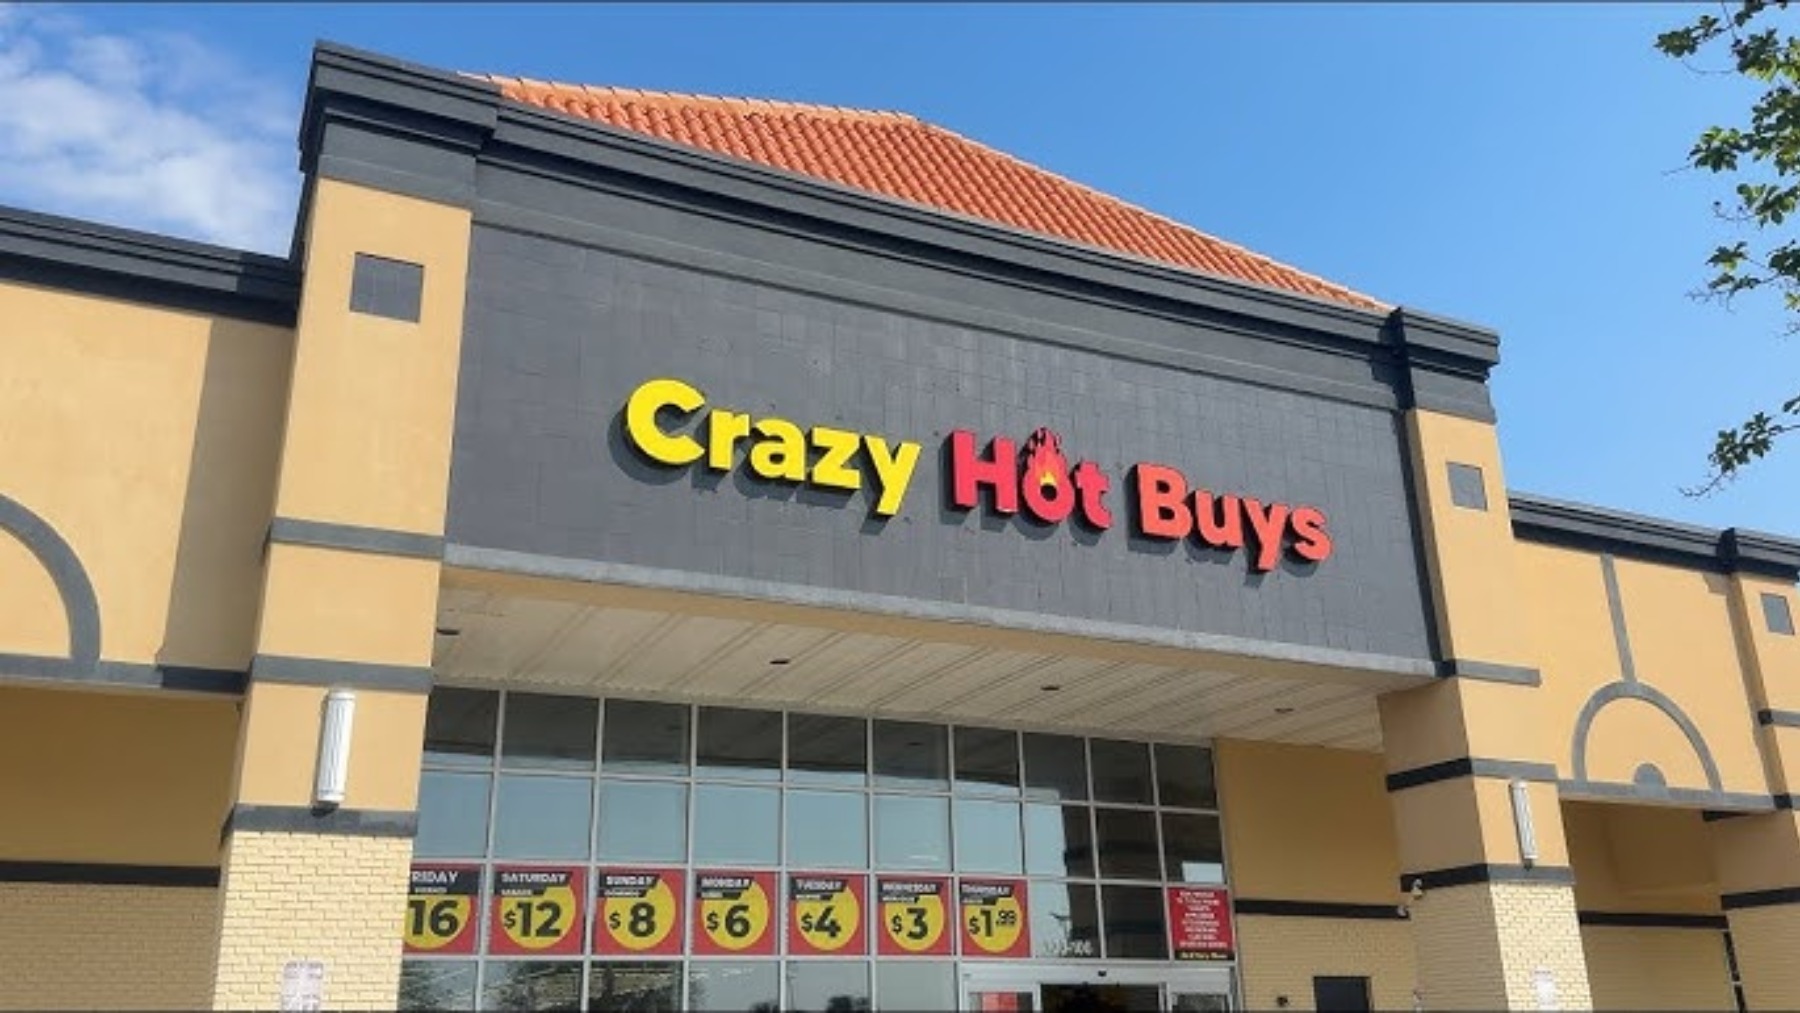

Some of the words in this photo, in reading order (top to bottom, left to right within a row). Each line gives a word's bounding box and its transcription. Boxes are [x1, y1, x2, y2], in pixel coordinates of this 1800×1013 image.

[626, 379, 922, 516] Crazy
[950, 427, 1112, 530] Hot
[1135, 462, 1333, 572] Buys
[411, 871, 458, 883] RIDAY
[501, 873, 566, 883] SATURDAY
[606, 876, 655, 885] SUNDAY
[701, 878, 750, 888] MONDAY
[796, 879, 842, 890] TUESDAY
[504, 901, 562, 938] $12
